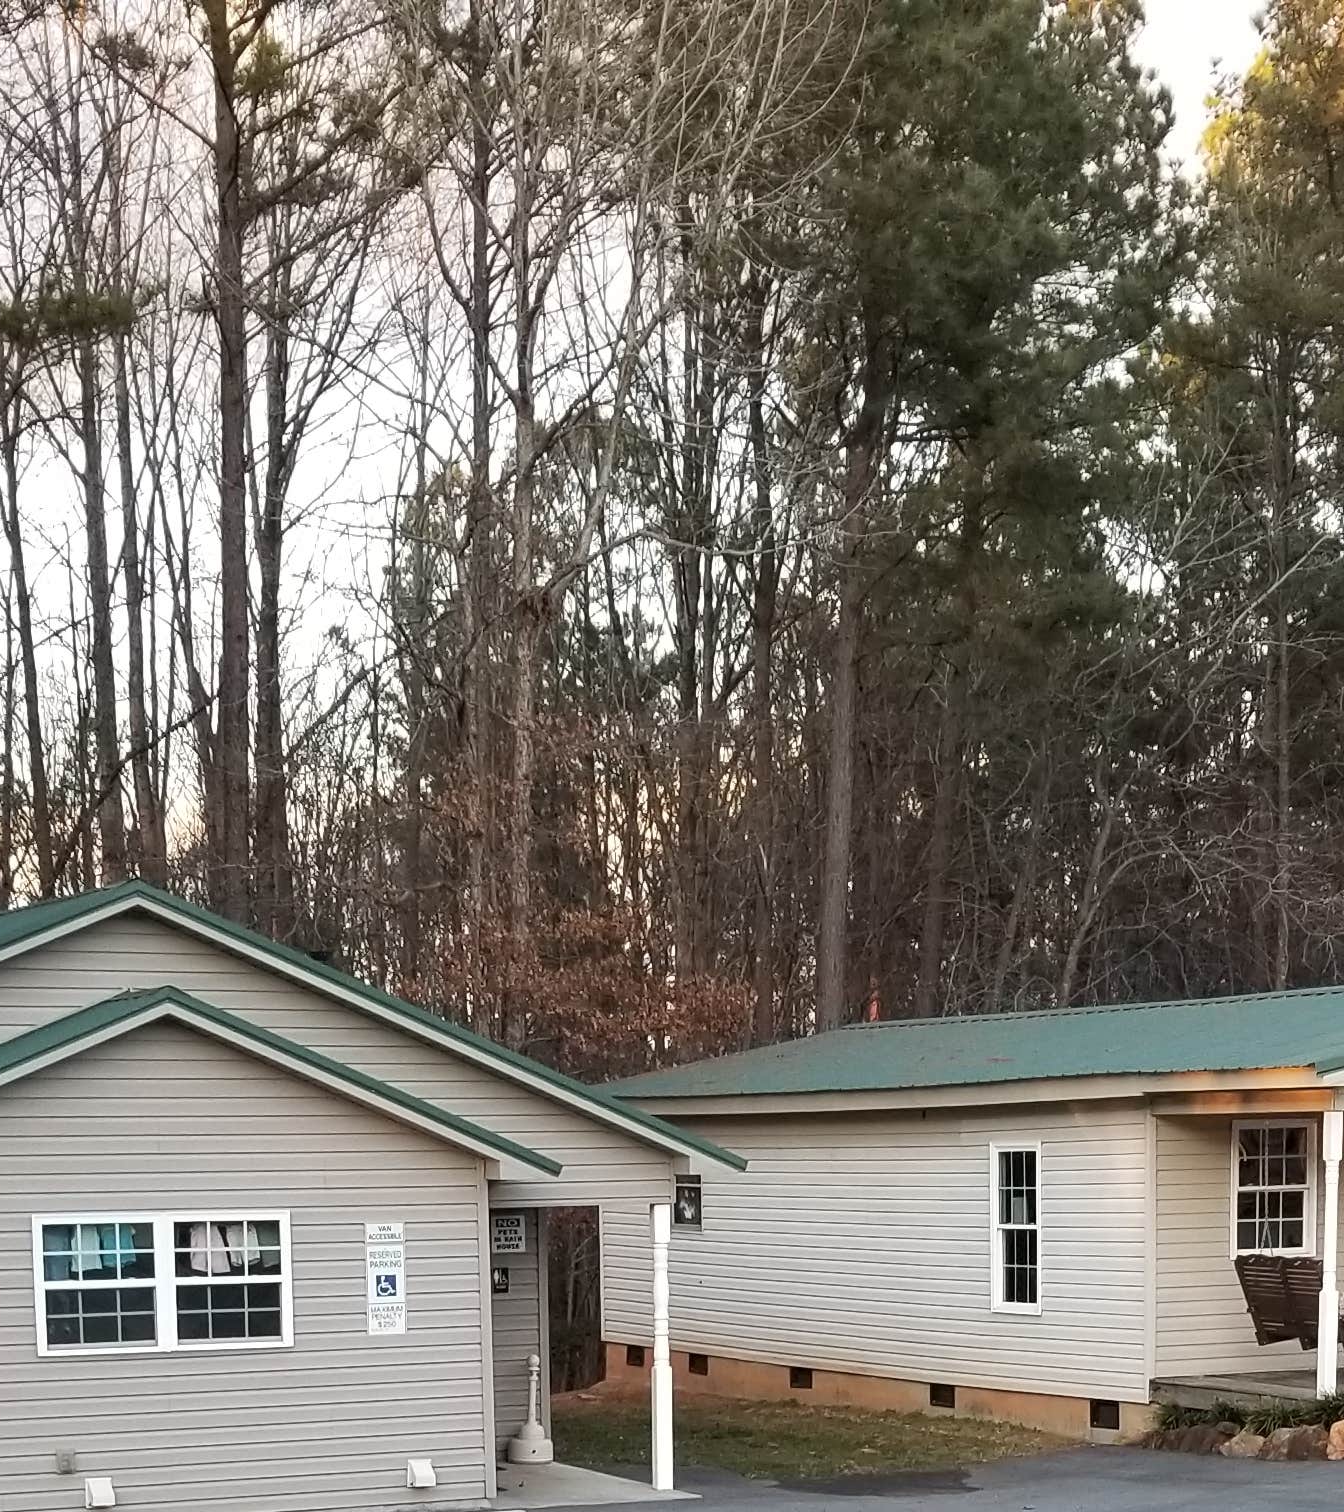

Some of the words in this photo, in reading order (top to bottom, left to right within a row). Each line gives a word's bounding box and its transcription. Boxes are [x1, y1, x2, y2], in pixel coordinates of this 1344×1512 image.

[497, 1219, 519, 1227] NO
[369, 1250, 402, 1259] RESERVED
[369, 1260, 402, 1268] PARKING
